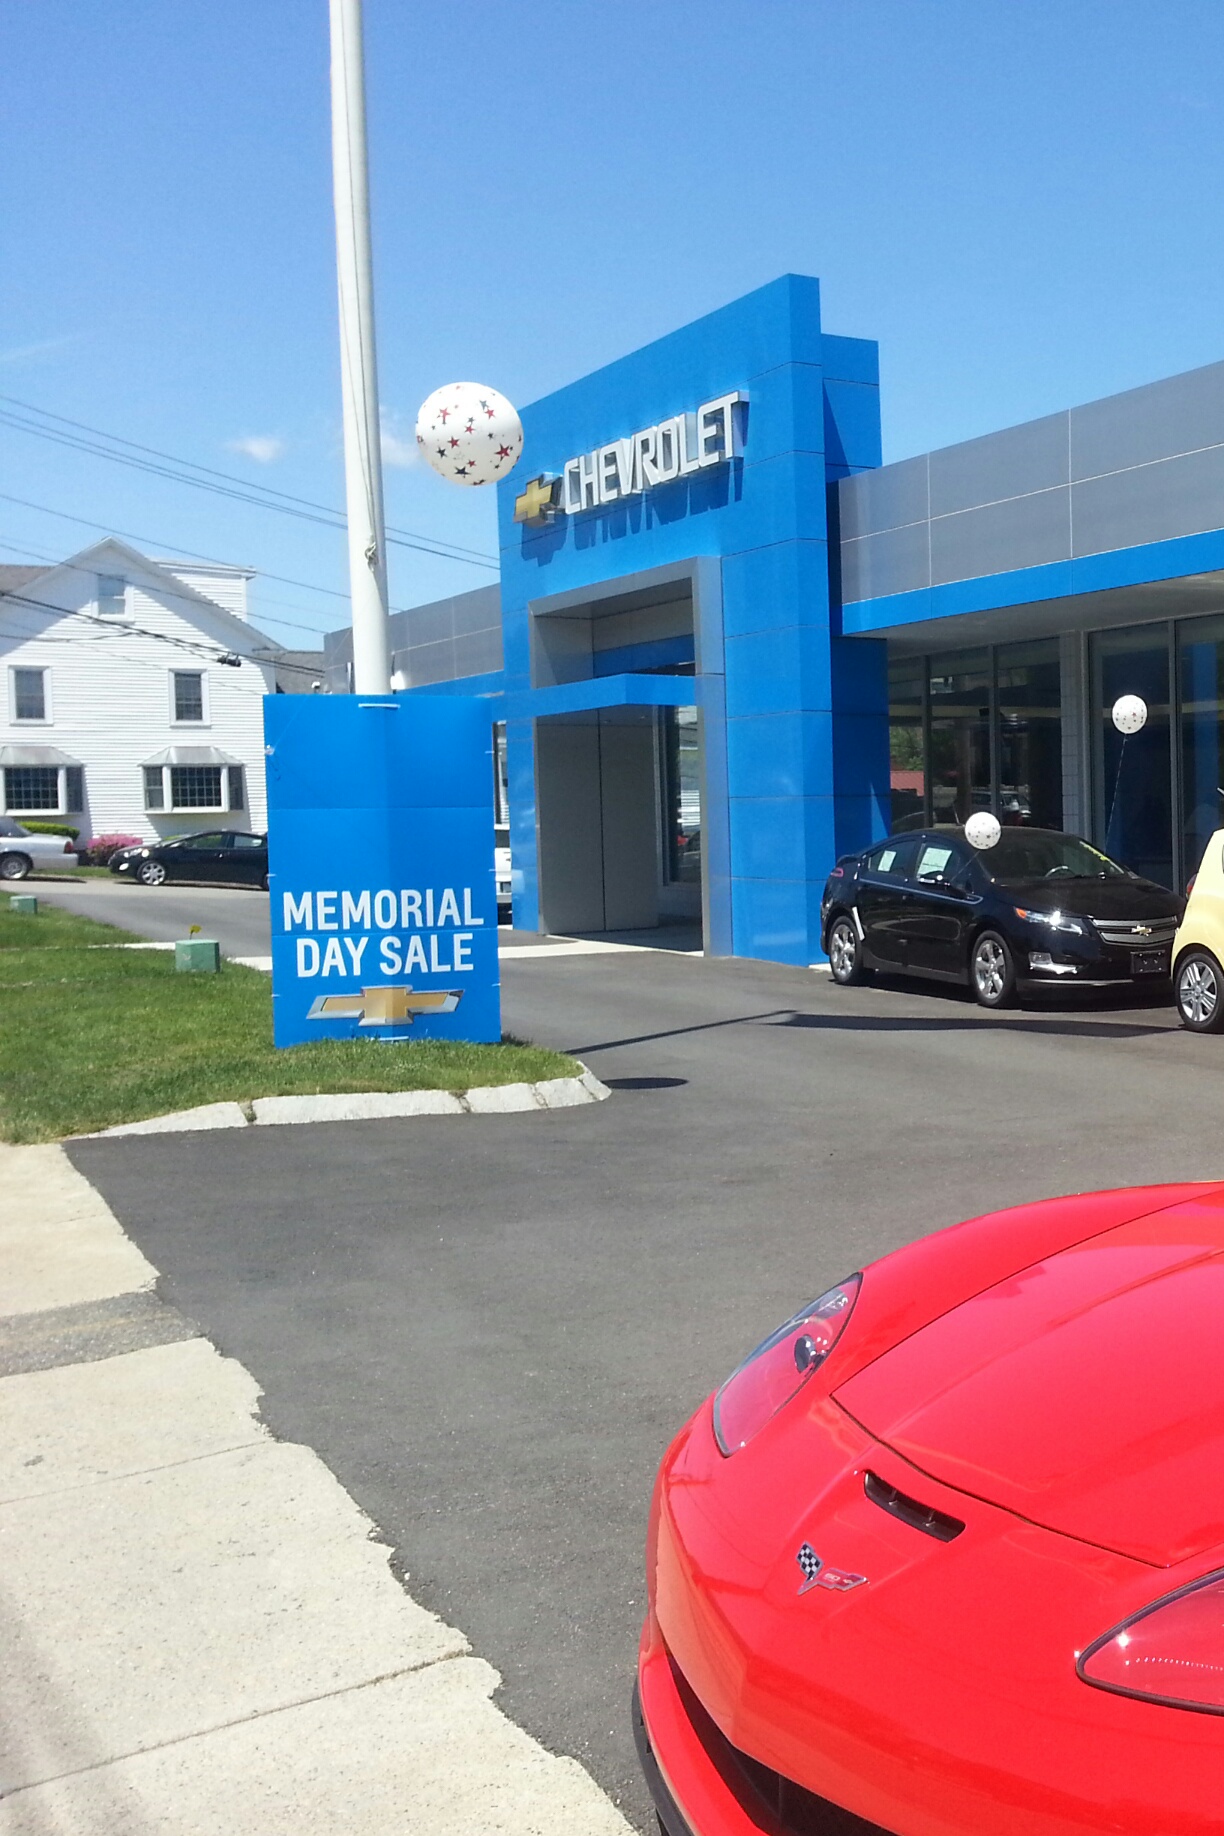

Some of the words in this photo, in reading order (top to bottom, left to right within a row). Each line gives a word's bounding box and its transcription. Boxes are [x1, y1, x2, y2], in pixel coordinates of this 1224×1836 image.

[562, 390, 746, 515] CHEVROLET
[282, 887, 485, 931] MEMORIAL
[296, 935, 369, 978] DAY
[379, 932, 475, 976] SALE
